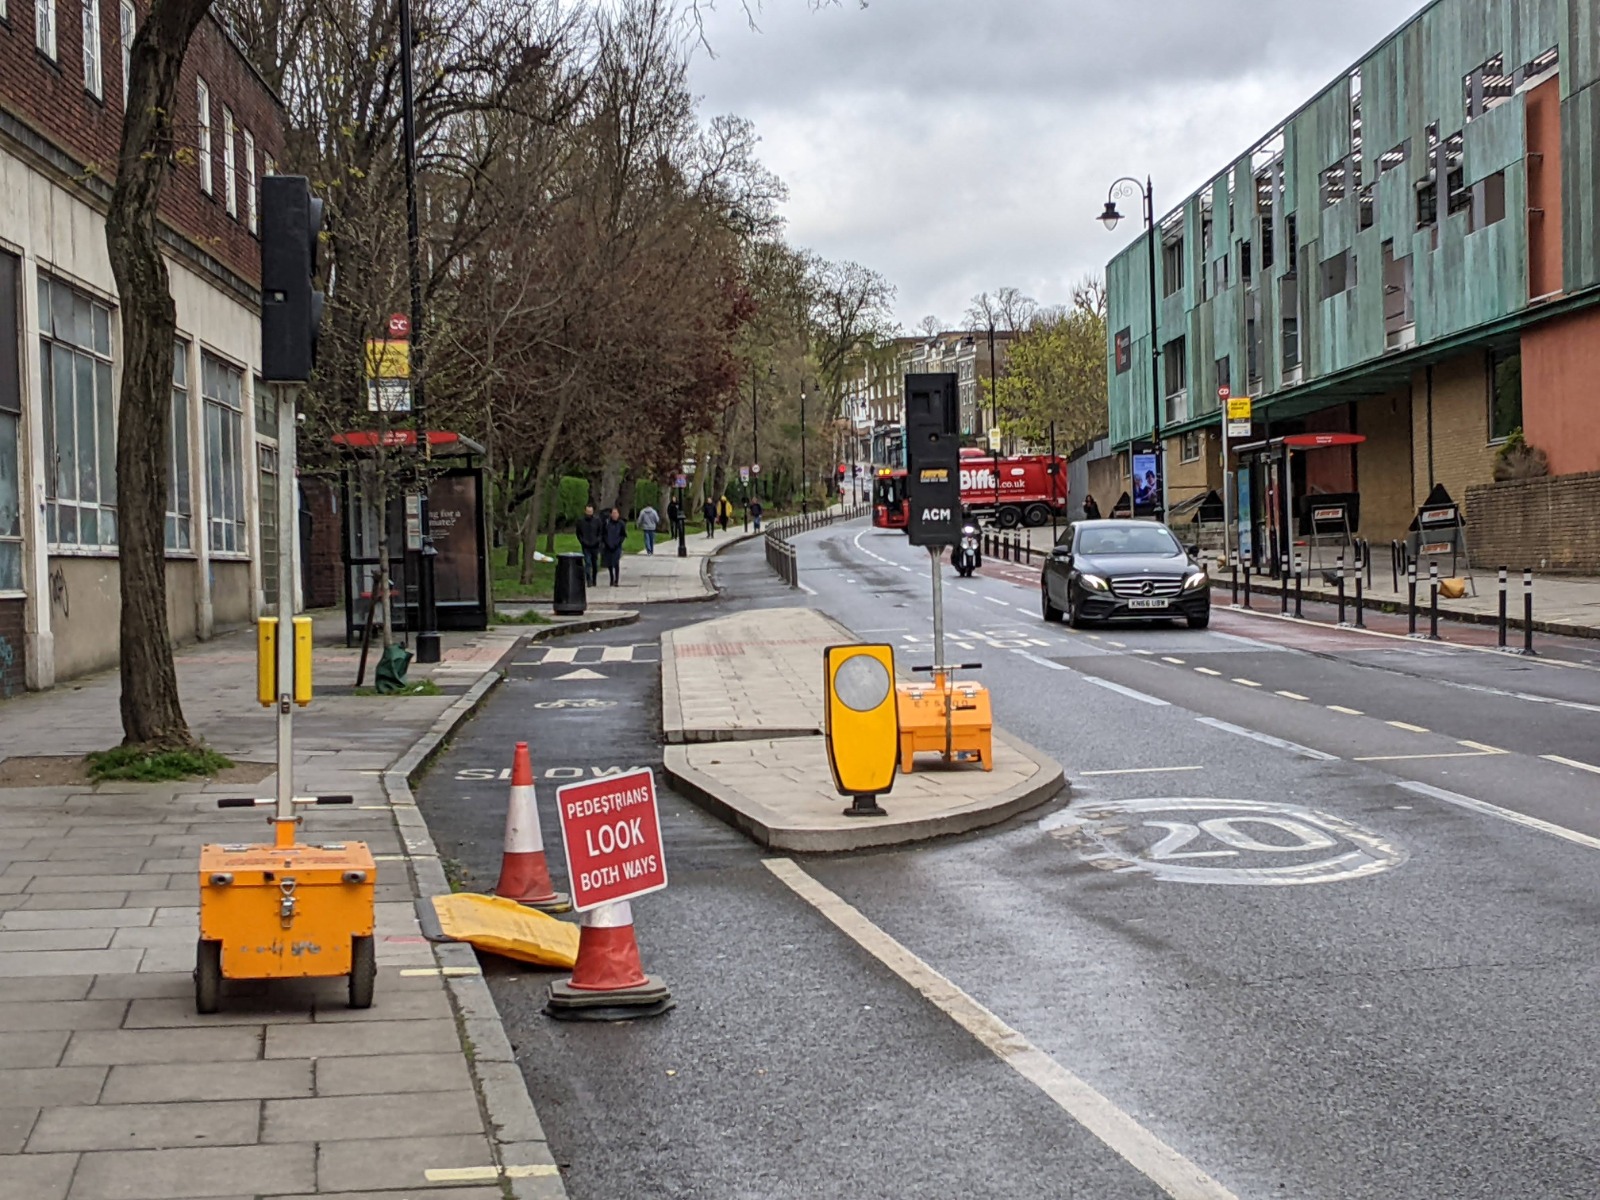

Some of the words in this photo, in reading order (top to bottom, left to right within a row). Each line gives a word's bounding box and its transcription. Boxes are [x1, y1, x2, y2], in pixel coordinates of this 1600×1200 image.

[922, 508, 951, 521] ACM
[567, 786, 649, 820] PEDESTRIANS
[586, 817, 645, 857] LOOK
[1143, 816, 1339, 860] 20
[580, 864, 620, 892] BOTH
[622, 854, 657, 879] WAYS
